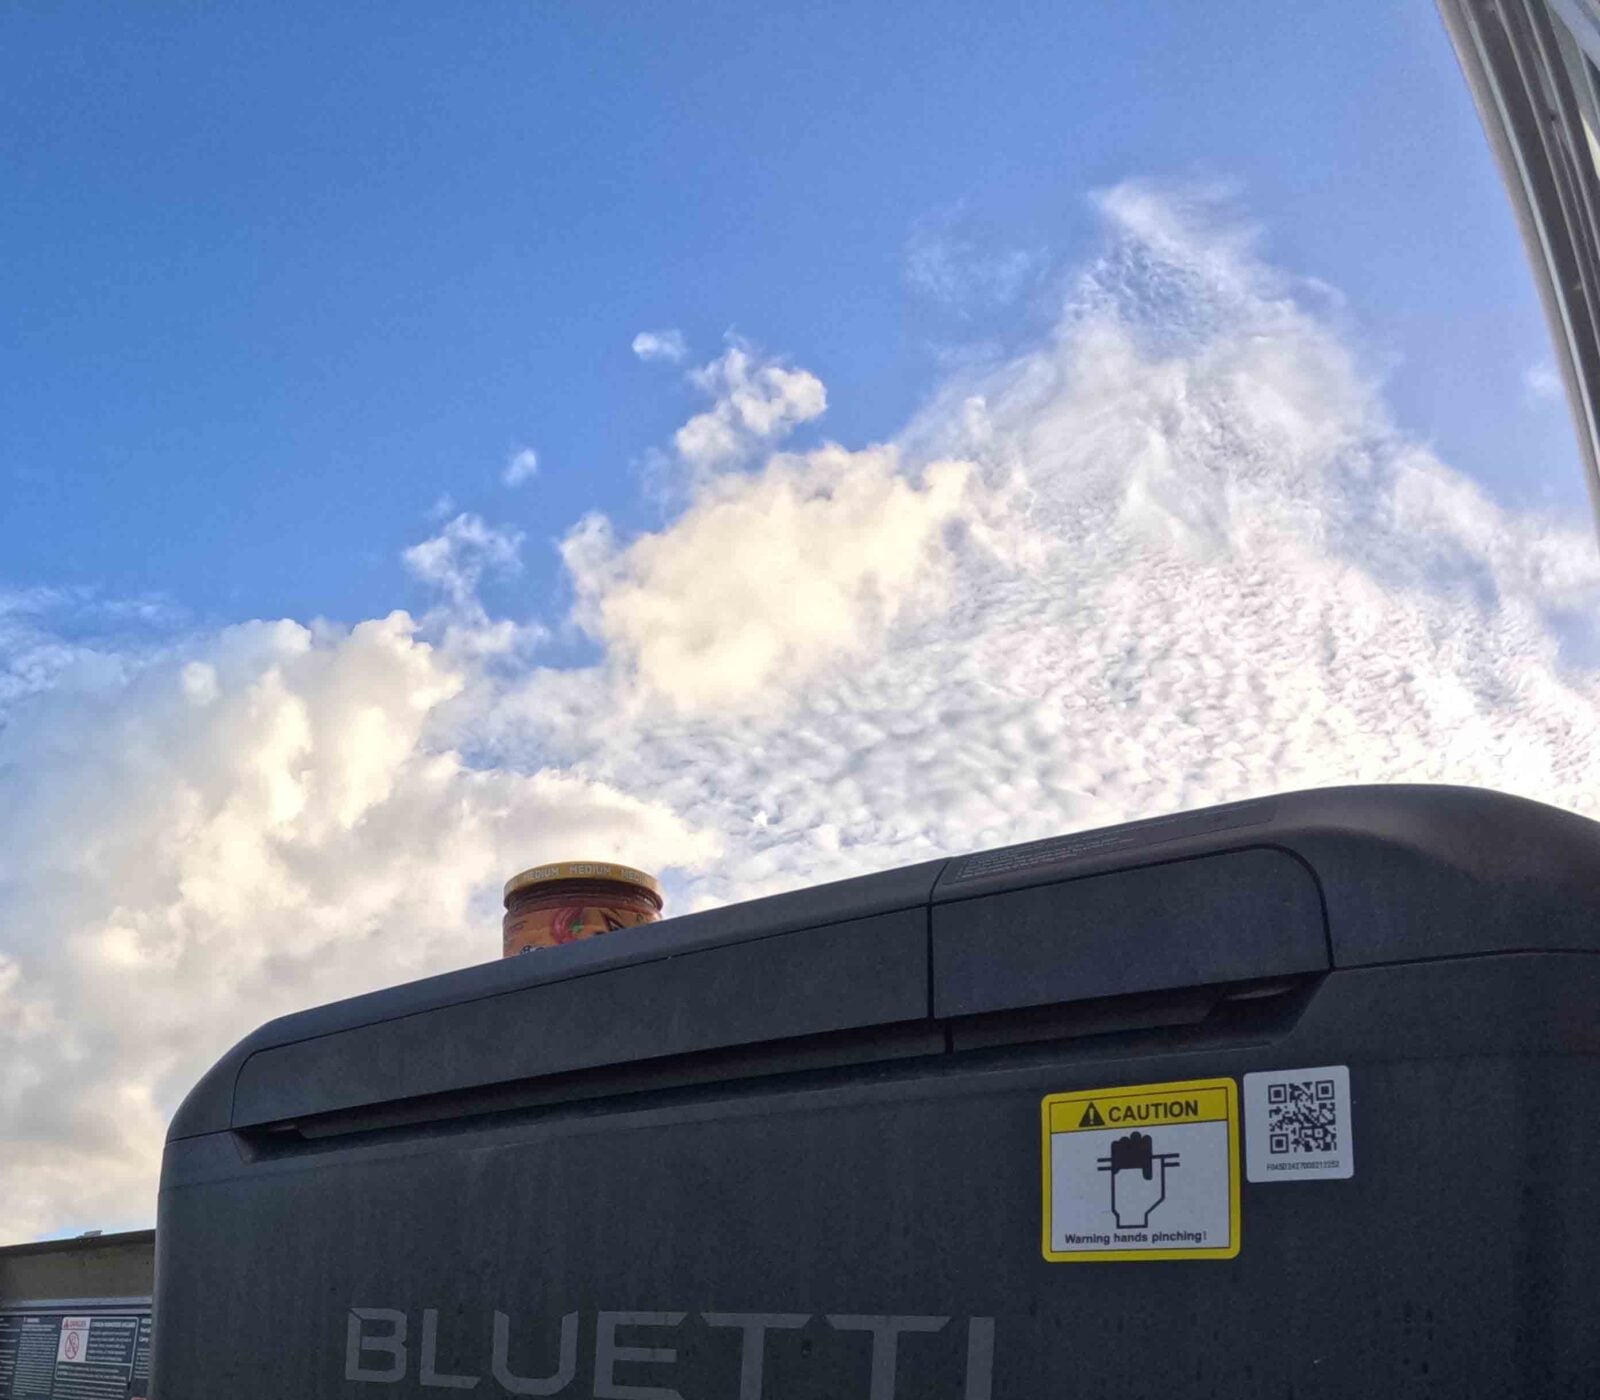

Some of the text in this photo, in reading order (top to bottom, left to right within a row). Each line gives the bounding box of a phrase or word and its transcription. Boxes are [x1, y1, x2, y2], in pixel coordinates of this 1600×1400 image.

[569, 864, 610, 875] MEDIUM
[1108, 1100, 1198, 1123] CAUTION
[1065, 1230, 1208, 1245] Warning hands pinching!
